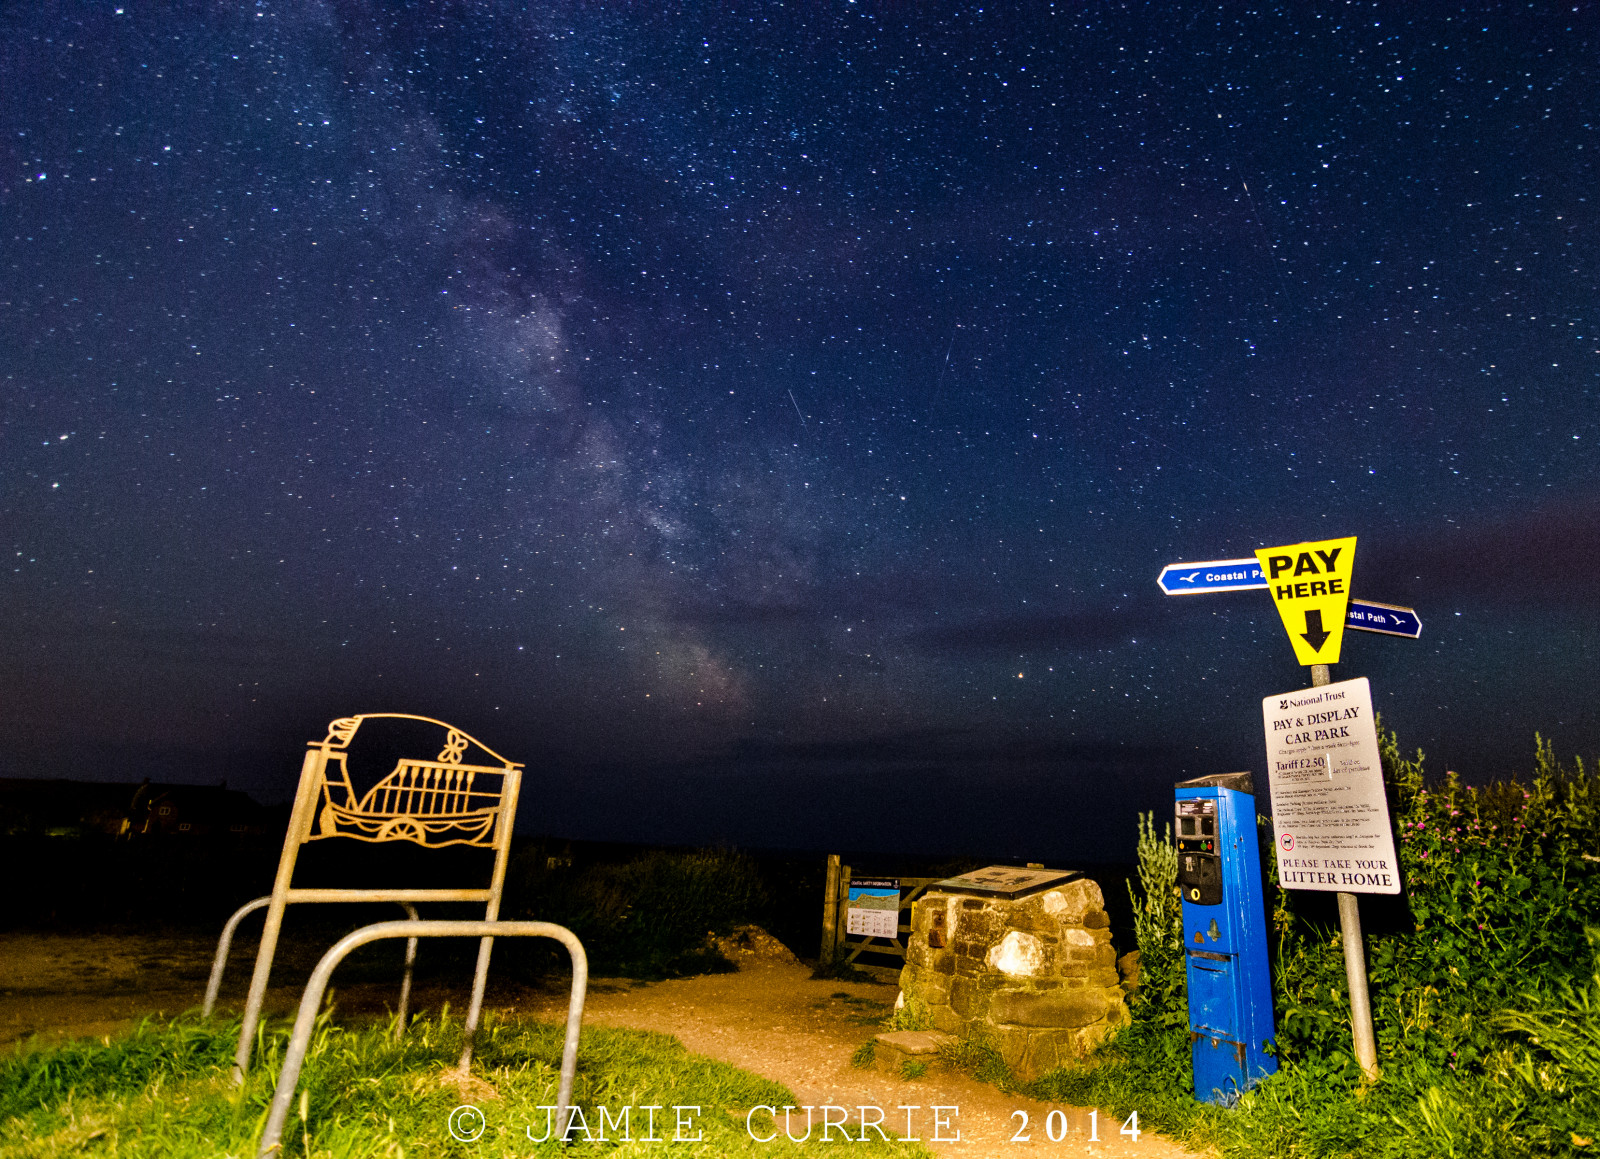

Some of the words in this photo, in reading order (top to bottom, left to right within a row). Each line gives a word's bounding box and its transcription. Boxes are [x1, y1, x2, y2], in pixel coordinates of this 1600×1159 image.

[1268, 547, 1342, 580] PAY
[1205, 570, 1247, 582] Coastal
[1276, 578, 1345, 600] HERE
[1367, 612, 1386, 624] Path
[1289, 694, 1323, 708] National
[1325, 691, 1346, 702] Trust
[1273, 718, 1293, 731] PAY
[1295, 717, 1304, 727] &
[1307, 706, 1360, 725] DISPLAY
[1285, 732, 1312, 745] CAR
[1315, 726, 1350, 741] PARK
[1275, 759, 1299, 771] Tariff
[1300, 757, 1325, 769] £2.50
[1282, 859, 1319, 868] PLEASE
[1324, 860, 1352, 869] TAKE
[1355, 860, 1389, 870] YOUR
[1283, 871, 1339, 885] LITTER
[1341, 872, 1392, 887] HOME
